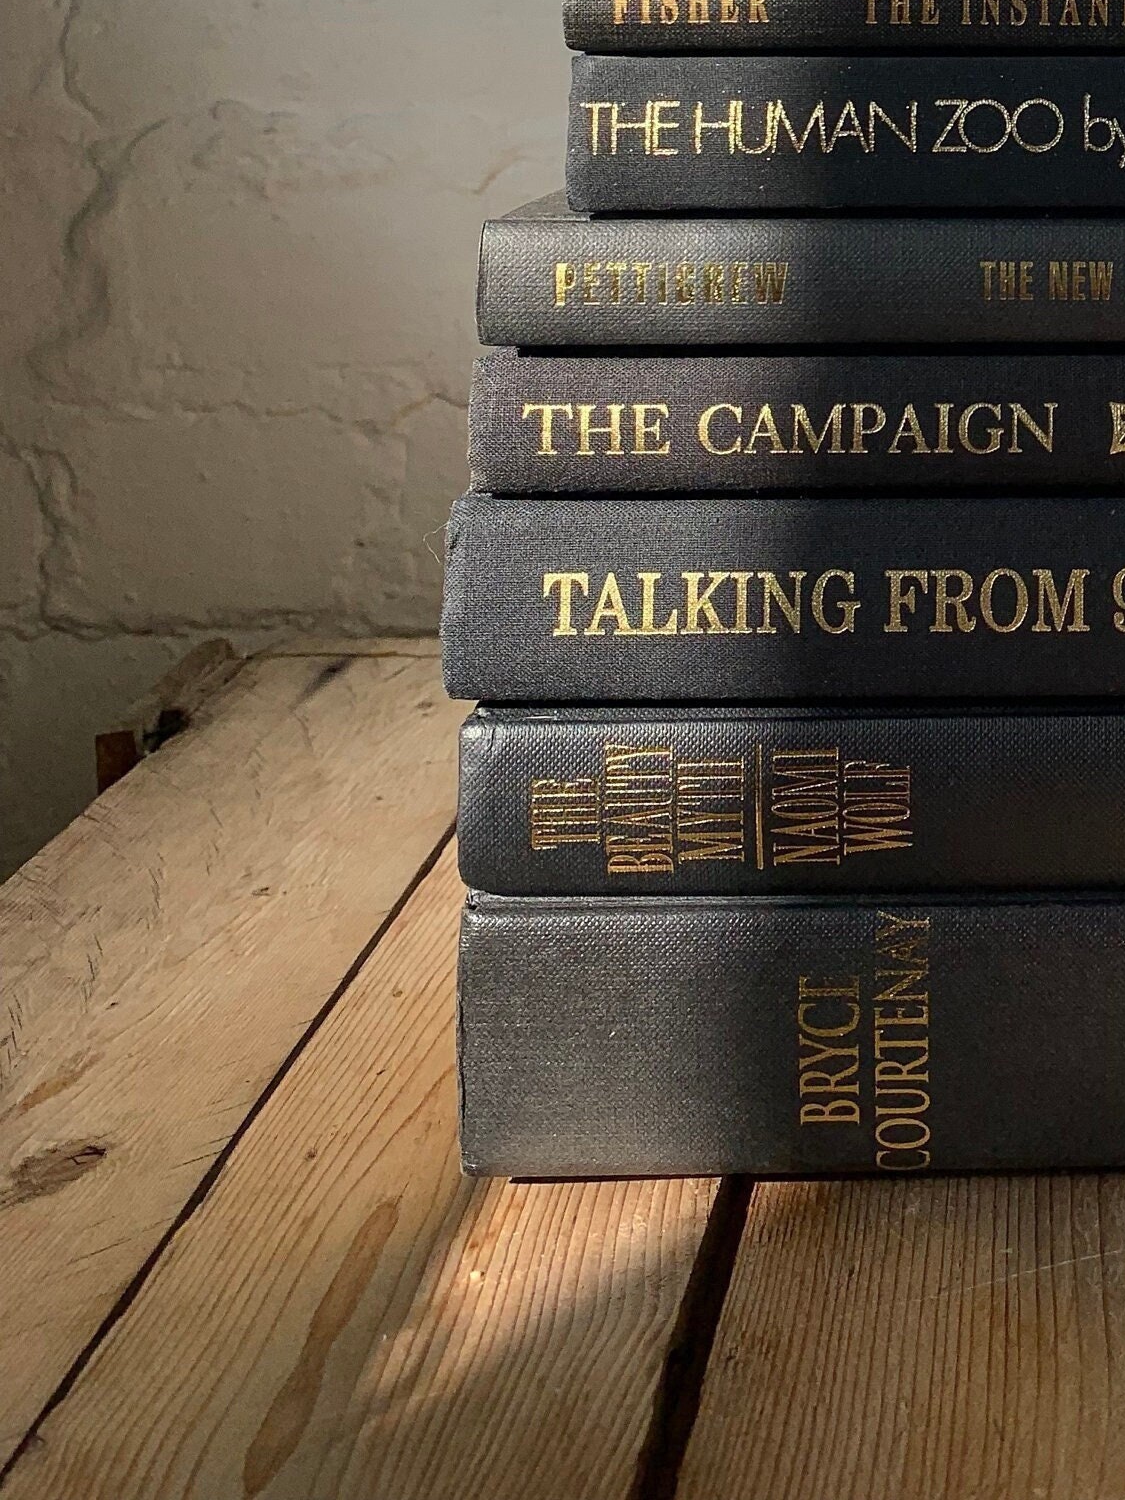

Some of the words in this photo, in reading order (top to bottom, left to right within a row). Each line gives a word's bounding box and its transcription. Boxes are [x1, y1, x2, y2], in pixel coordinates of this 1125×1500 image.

[581, 100, 679, 155] THE
[692, 99, 918, 155] HUMAN
[932, 98, 1064, 154] ZOO
[553, 262, 789, 307] PETTIGREW
[980, 261, 1036, 300] THE
[1048, 261, 1114, 300] NEW
[522, 404, 671, 455] THE
[698, 401, 1059, 454] CAMPAIGN
[543, 568, 861, 635] TALKING
[885, 568, 1091, 634] FROM
[532, 778, 599, 851] THE
[605, 744, 673, 874] BEAUTY
[678, 757, 744, 864] MYTH
[771, 747, 839, 865] NAOMI
[843, 760, 912, 855] WOLF
[798, 974, 860, 1125] BRYCE
[874, 911, 931, 1171] COURTENAY
